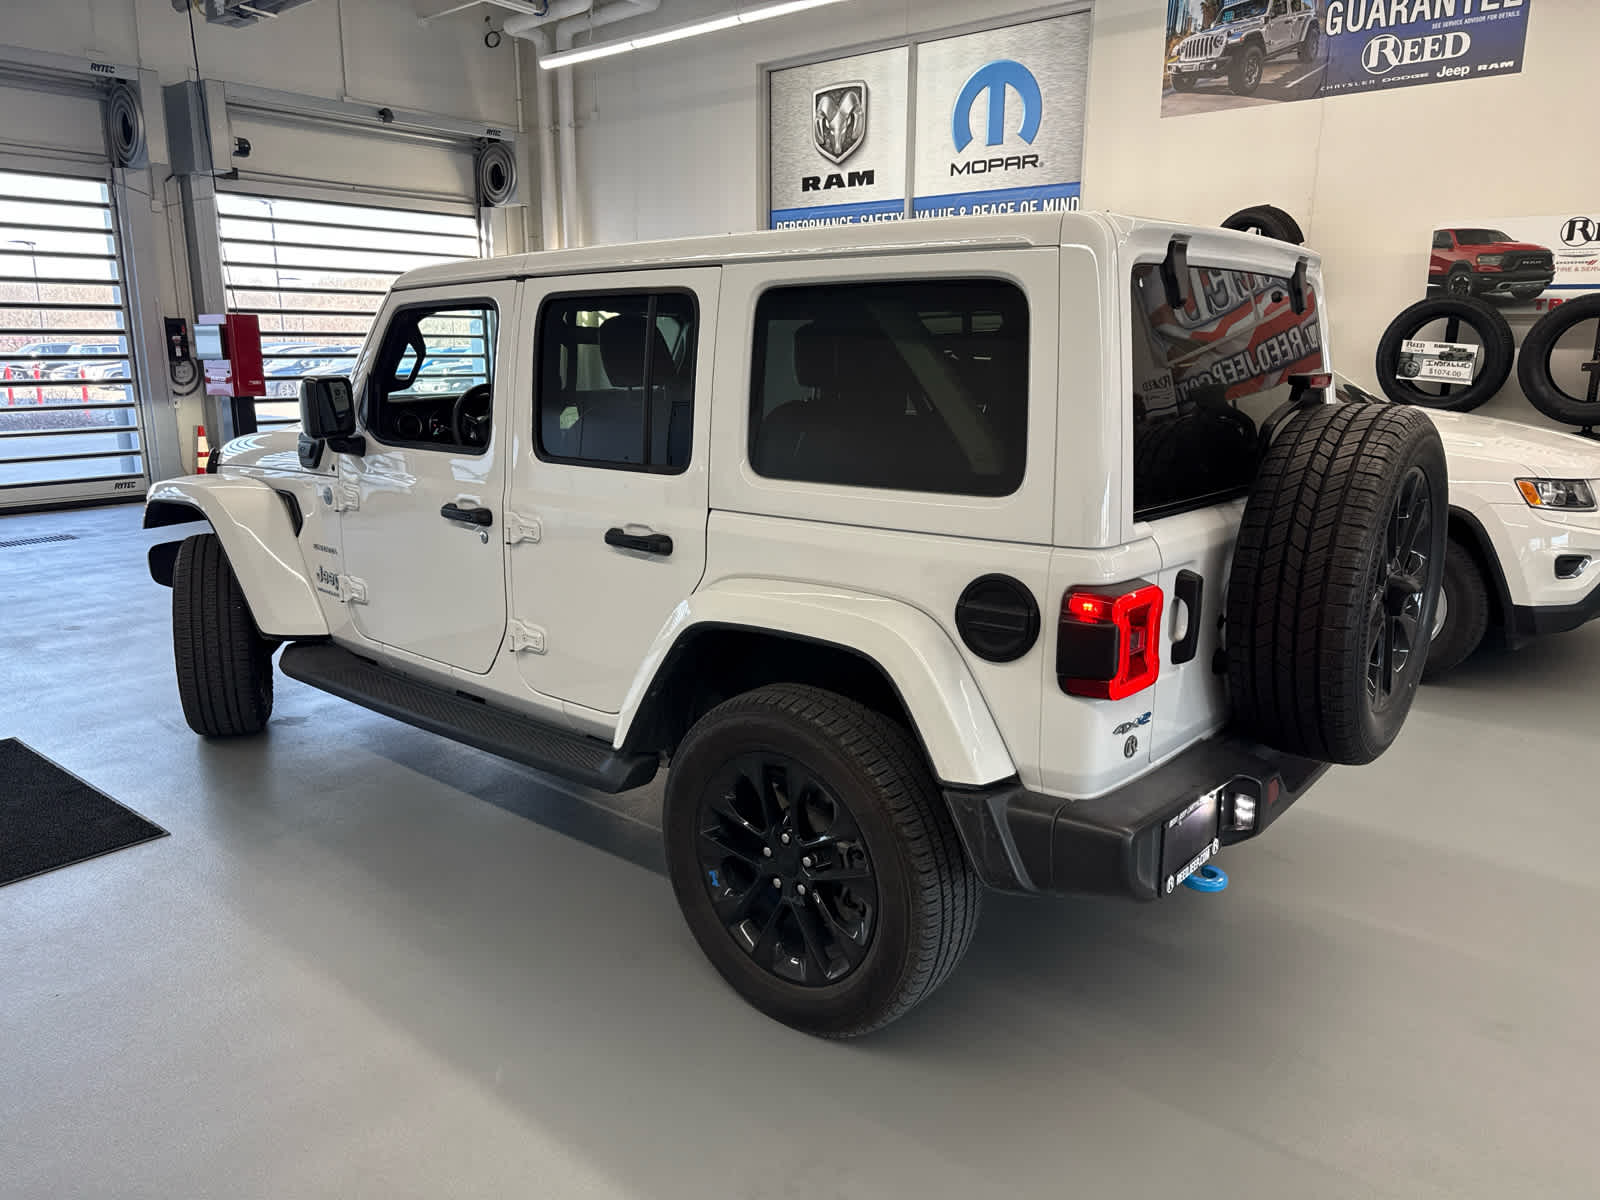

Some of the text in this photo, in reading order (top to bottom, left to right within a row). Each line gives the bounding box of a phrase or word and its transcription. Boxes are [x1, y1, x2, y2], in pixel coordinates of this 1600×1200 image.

[1326, 0, 1523, 36] GUARAN
[1443, 19, 1462, 27] SERVICE
[1464, 15, 1486, 24] ADVISOR
[1498, 10, 1520, 19] DETAILS
[1362, 31, 1471, 74] REED
[90, 62, 115, 73] RYTEC
[1320, 60, 1514, 91] CHRYSLER DODGE Jeep RAM
[801, 169, 875, 192] RAM
[1043, 196, 1080, 212] MIND
[114, 481, 136, 490] RYTEC
